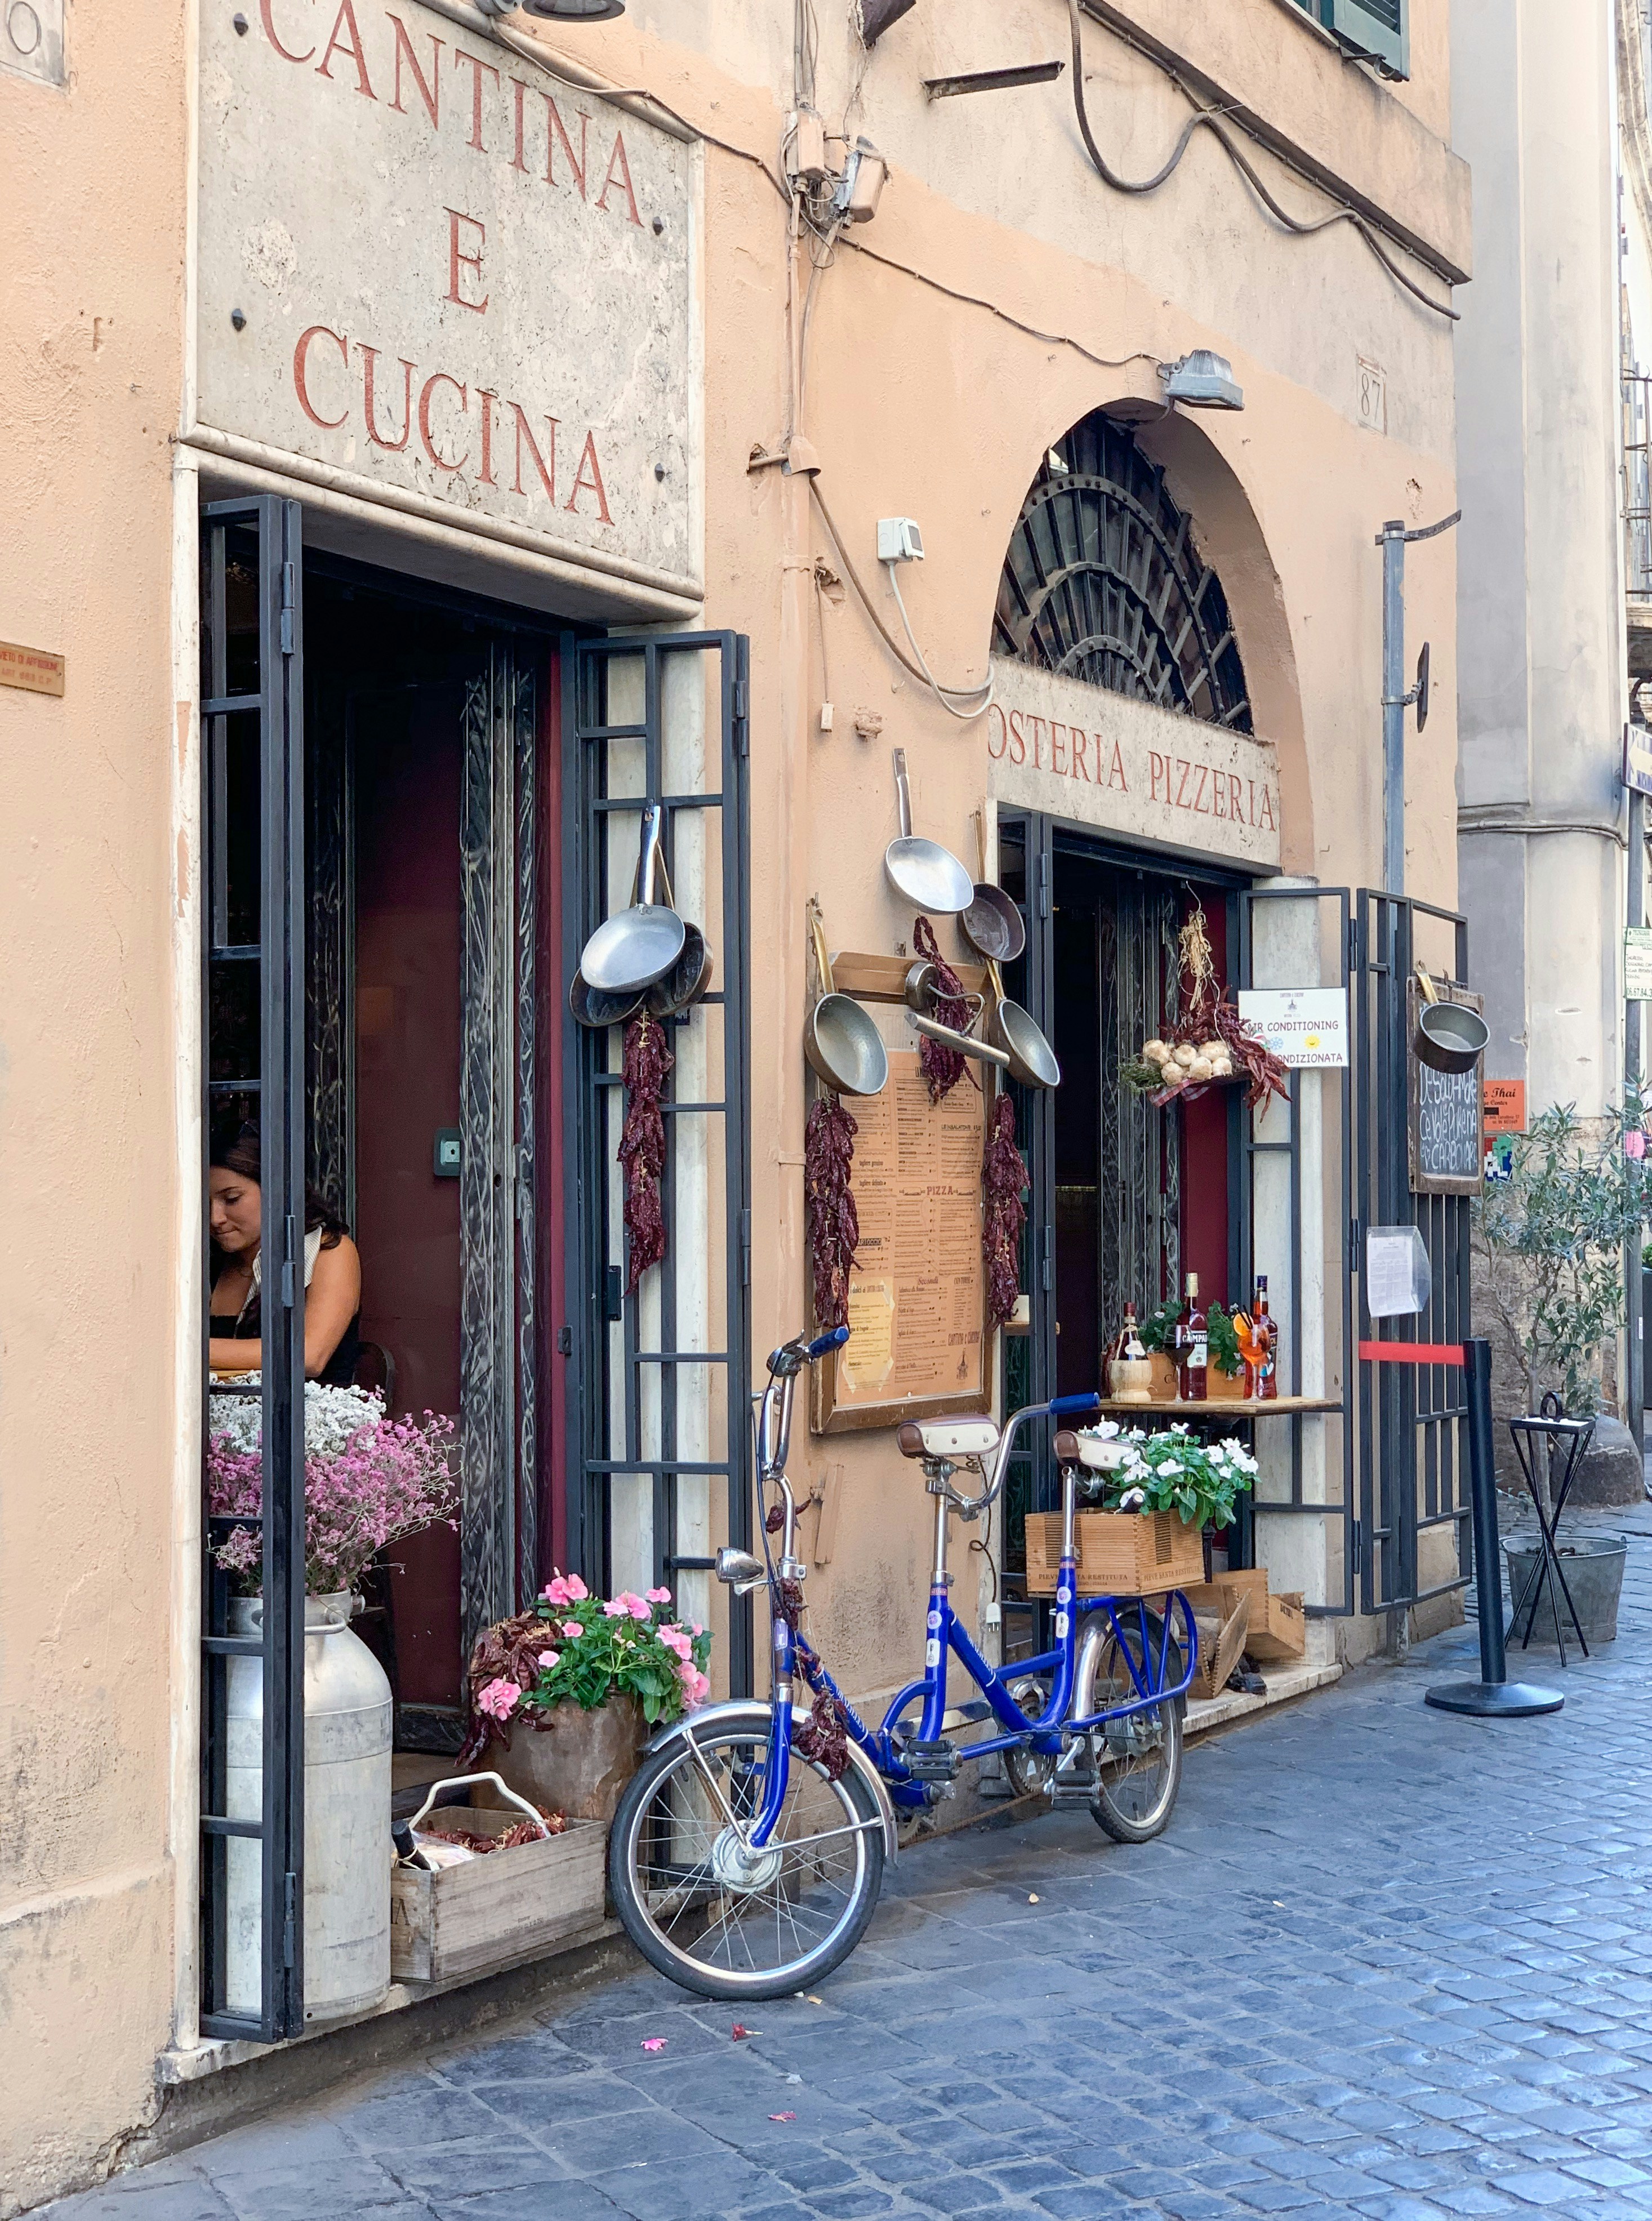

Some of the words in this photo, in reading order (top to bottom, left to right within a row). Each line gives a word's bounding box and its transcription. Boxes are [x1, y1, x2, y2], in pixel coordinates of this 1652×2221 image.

[259, 0, 645, 229] CANTINA
[442, 206, 489, 315] E
[1360, 372, 1382, 421] 87
[293, 326, 615, 527] CUCINA
[988, 703, 1128, 793] OSTERIA
[1148, 750, 1276, 832] PIZZERIA
[1267, 1020, 1338, 1032] CONDITIONING
[1280, 1053, 1343, 1063] ONDIZIONATA
[1491, 1087, 1516, 1097] Thai
[927, 1186, 954, 1196] PIZZA
